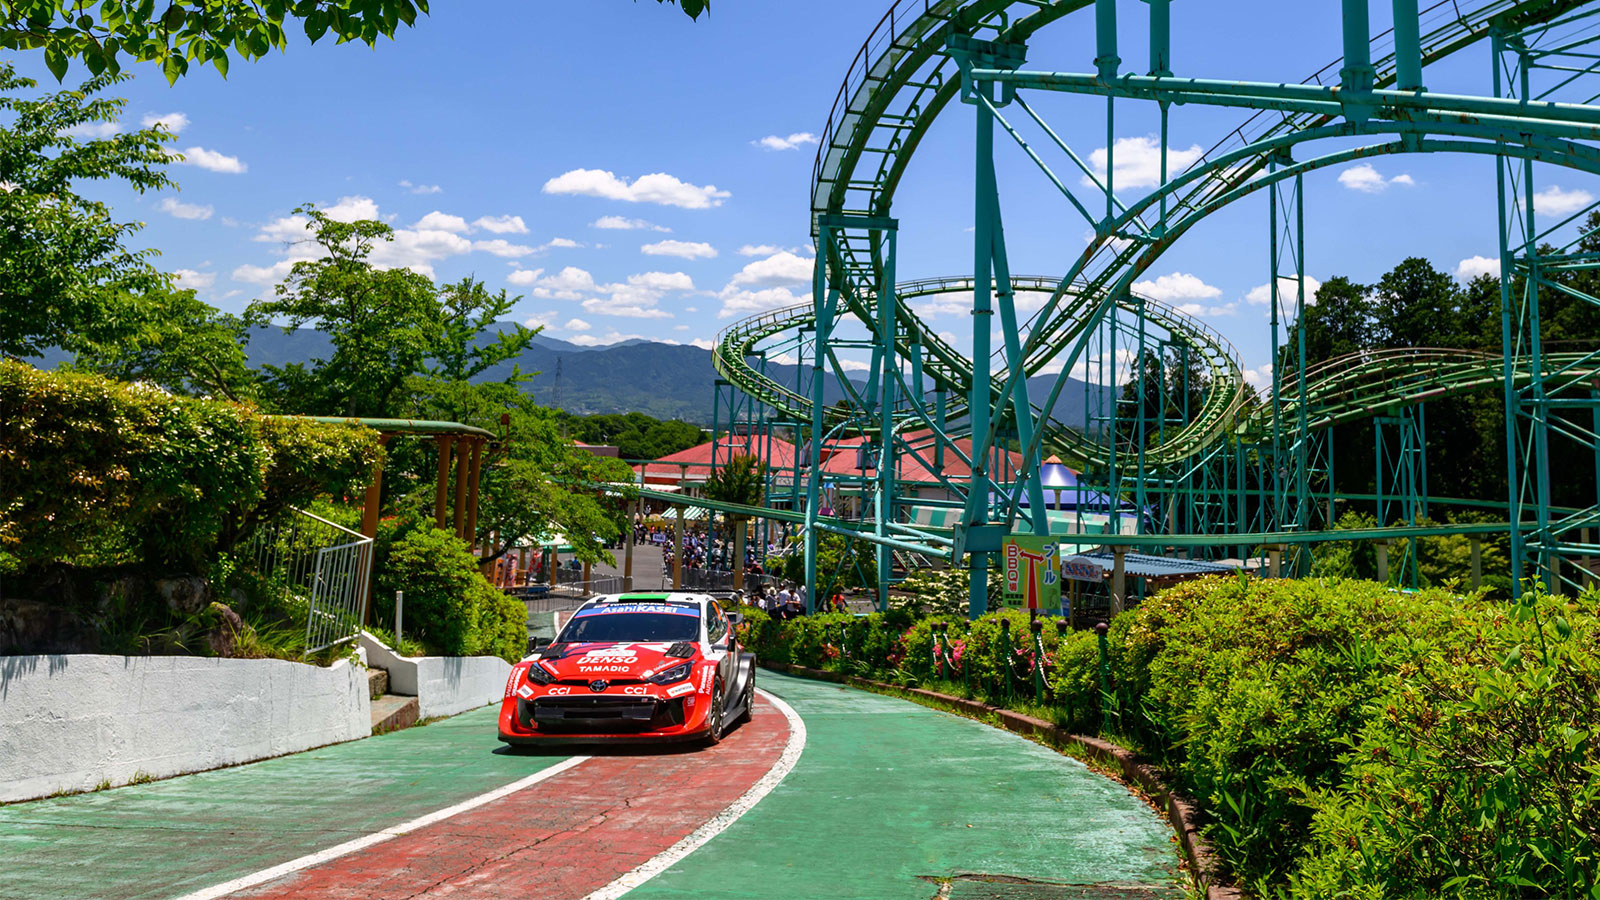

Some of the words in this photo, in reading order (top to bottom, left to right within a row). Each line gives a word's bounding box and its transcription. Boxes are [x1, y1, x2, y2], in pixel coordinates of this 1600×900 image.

[1044, 541, 1058, 584] プール
[576, 656, 638, 664] DENSO
[548, 687, 571, 695] CCI
[624, 686, 647, 694] CCI
